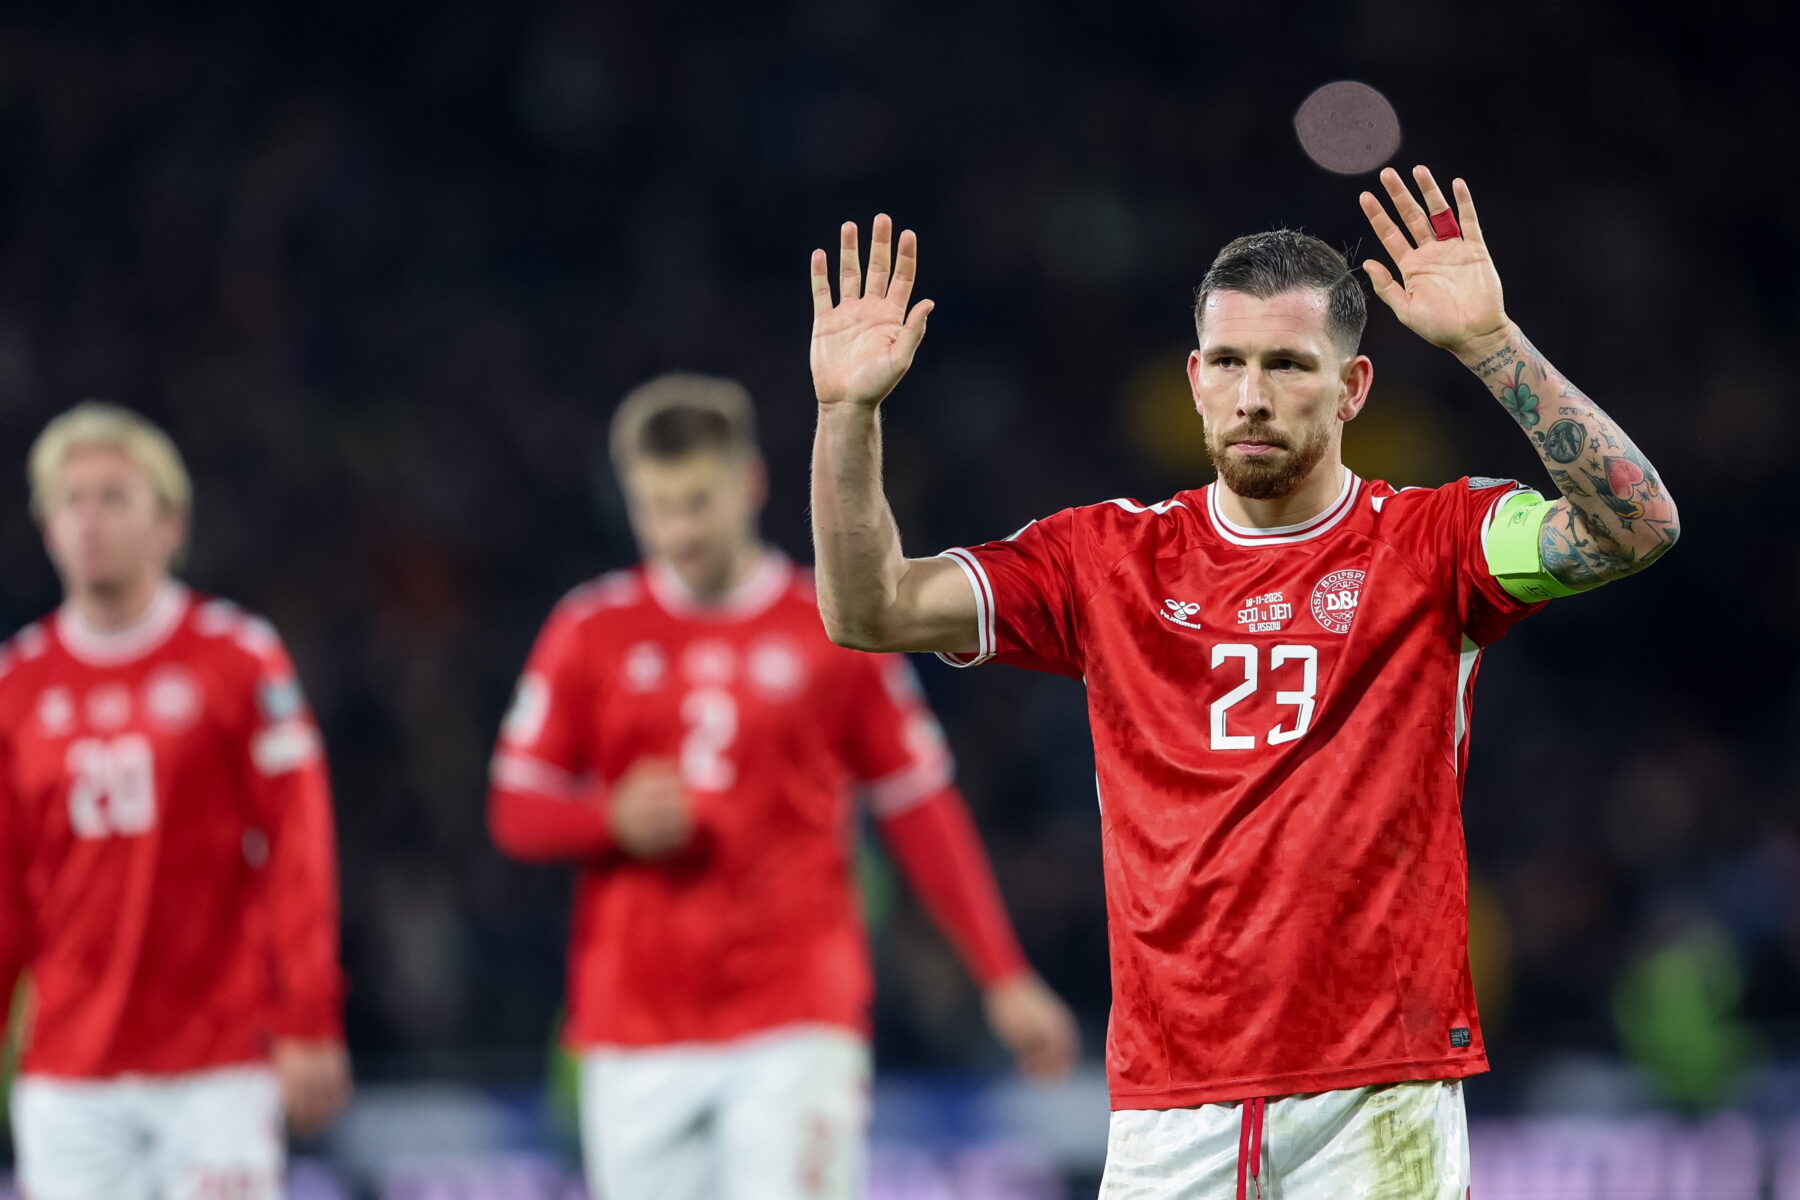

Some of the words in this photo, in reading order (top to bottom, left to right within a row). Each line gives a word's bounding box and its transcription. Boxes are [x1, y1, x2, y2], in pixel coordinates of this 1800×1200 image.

[1320, 571, 1367, 589] BOLDSPI
[1160, 608, 1202, 630] hummel
[1237, 607, 1258, 624] SCO
[1269, 602, 1292, 620] DEN
[1313, 590, 1332, 627] DANSK
[1249, 621, 1281, 633] GLASGOW
[1210, 643, 1318, 751] 23
